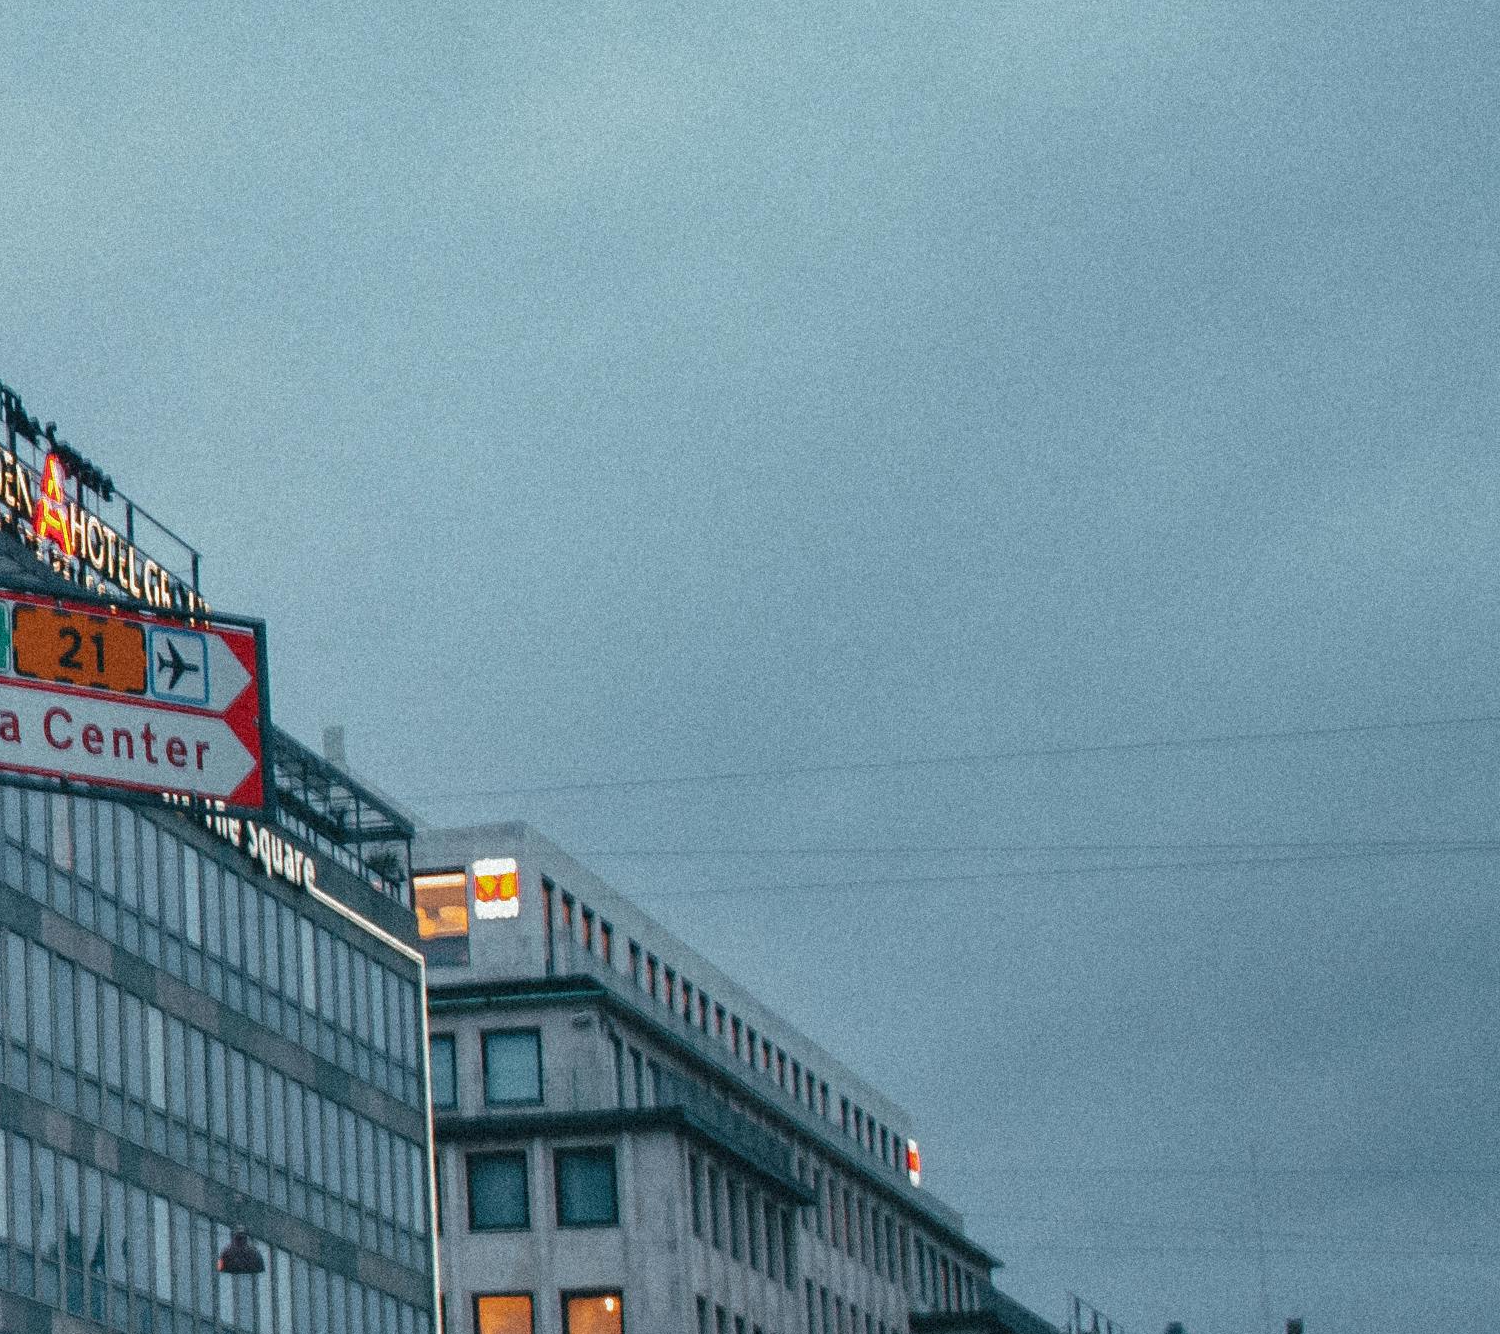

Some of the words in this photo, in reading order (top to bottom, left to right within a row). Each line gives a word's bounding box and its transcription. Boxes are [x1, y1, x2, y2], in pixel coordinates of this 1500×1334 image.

[70, 502, 142, 600] HOTEL
[59, 627, 107, 673] 21
[44, 708, 211, 771] Center
[246, 820, 316, 893] Square
